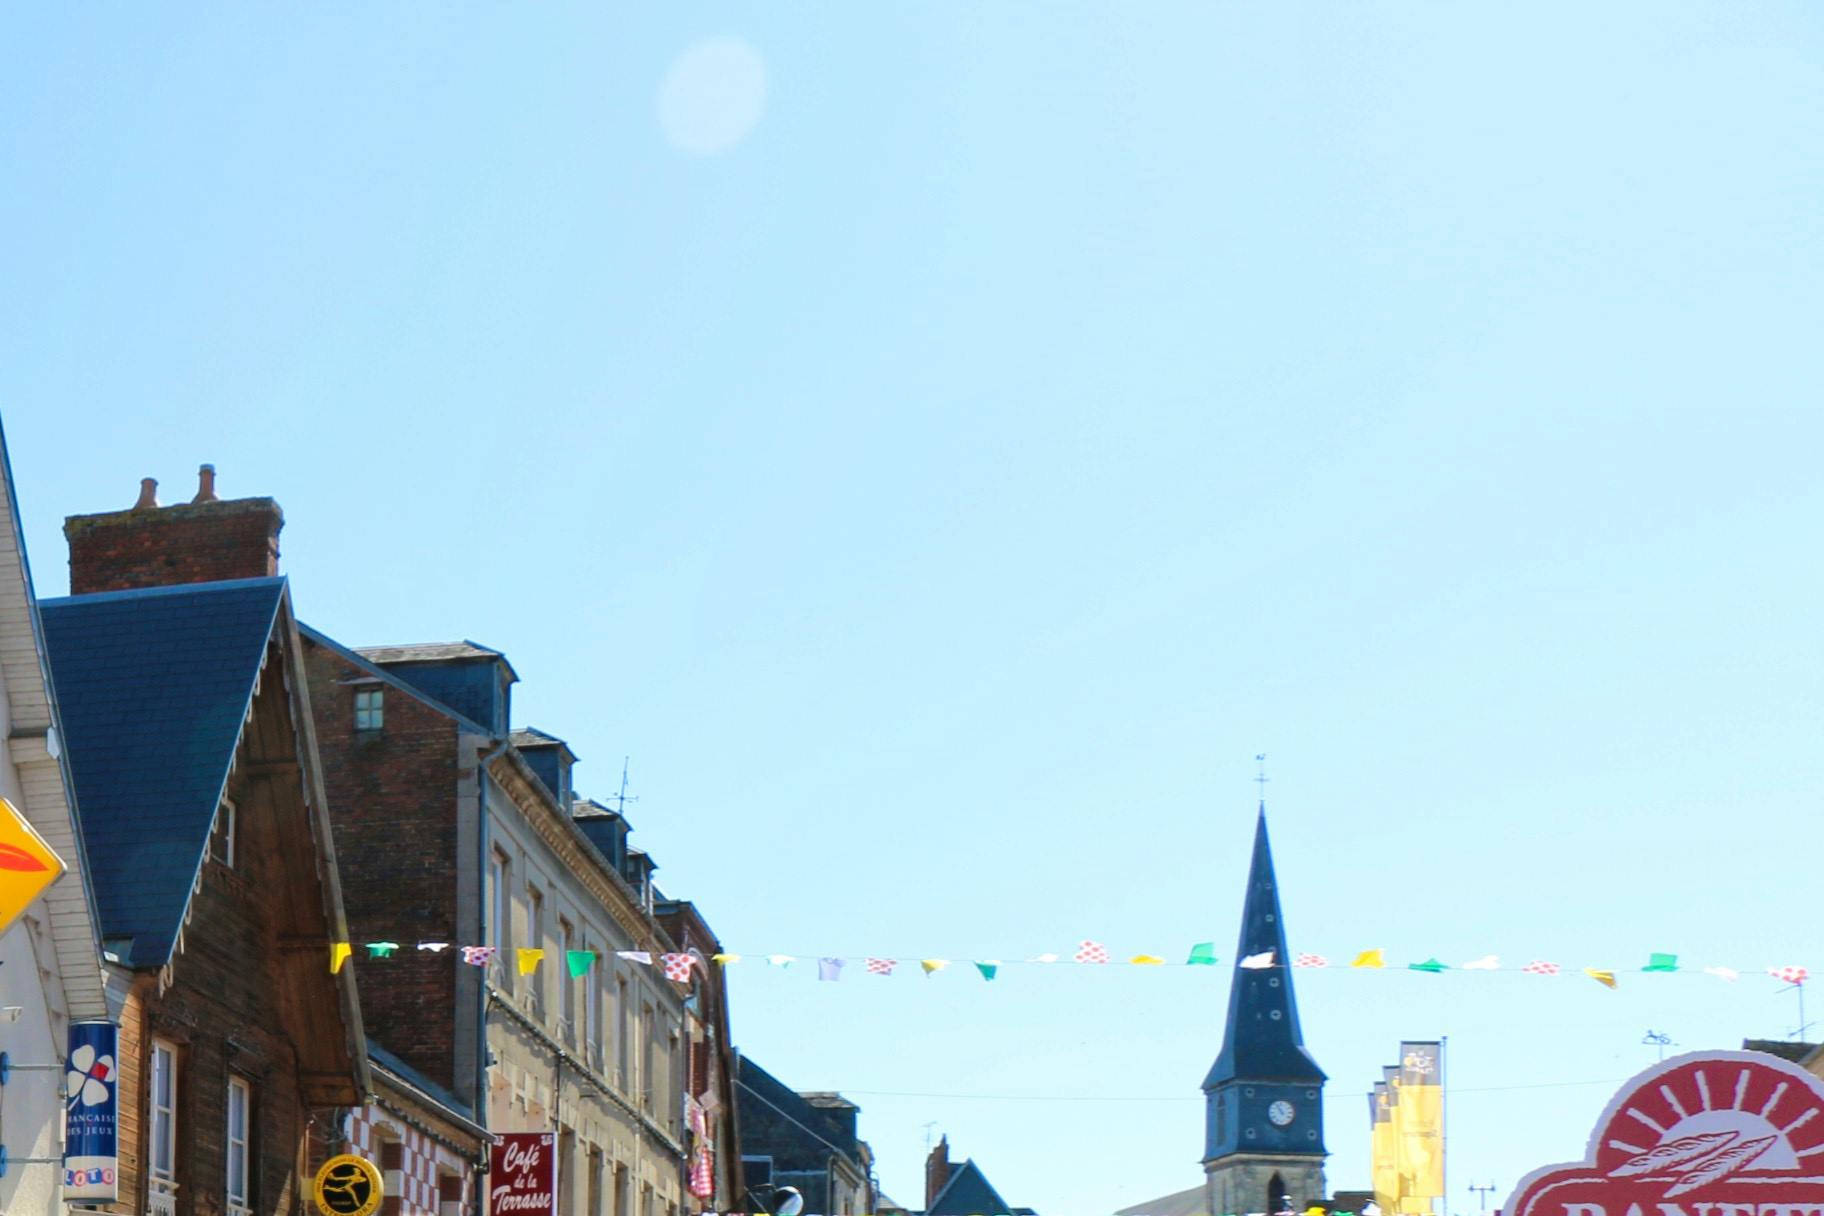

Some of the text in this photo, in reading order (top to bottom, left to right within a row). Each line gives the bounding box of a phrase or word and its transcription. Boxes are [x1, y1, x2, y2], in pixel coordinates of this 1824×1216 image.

[86, 1126, 113, 1136] JEUX
[503, 1142, 540, 1174] Café
[65, 1168, 115, 1186] LOTO
[513, 1173, 537, 1188] de la
[492, 1185, 552, 1215] Terrasse
